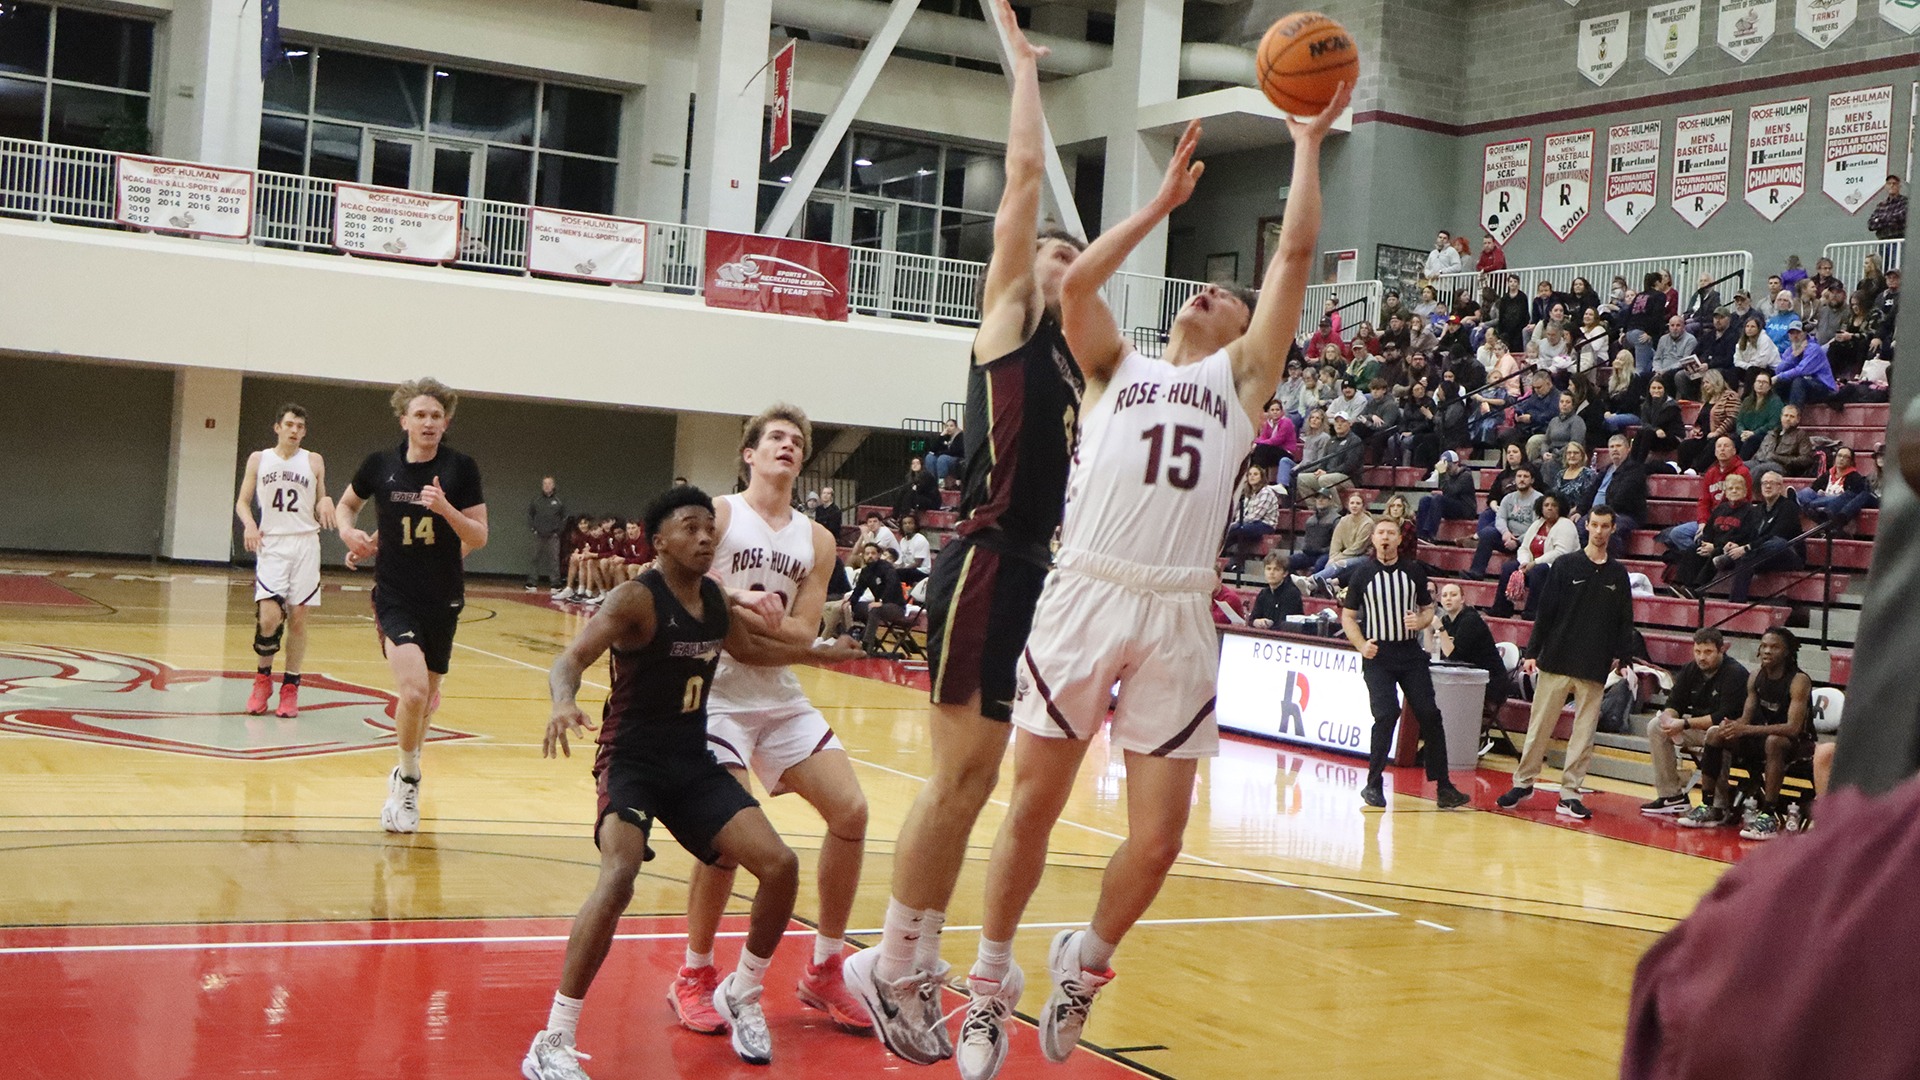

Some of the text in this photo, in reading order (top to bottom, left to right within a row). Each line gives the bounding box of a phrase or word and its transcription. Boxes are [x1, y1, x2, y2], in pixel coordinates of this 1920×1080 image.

[1660, 14, 1686, 24] UNIVERSITY
[1812, 10, 1840, 22] TRANSY
[1590, 19, 1619, 30] MANCHESTER
[1592, 26, 1617, 36] UNIVERSITY
[1812, 23, 1838, 33] PIONEERS
[1591, 62, 1613, 72] SPARTANS
[1844, 111, 1872, 123] MEN'S
[1765, 123, 1791, 135] MEN'S
[1828, 120, 1888, 136] BASKETBALL
[1610, 138, 1658, 156] MEN'S BASKETBALL
[1691, 134, 1715, 145] MEN'S
[1750, 133, 1805, 148] BASKETBALL
[1829, 134, 1887, 146] REGULAR SEASON
[1546, 151, 1590, 163] BASKETBALL
[1677, 142, 1728, 158] BASKETBALL
[1752, 147, 1803, 165] Heartland
[1828, 141, 1886, 159] CHAMPIONS
[1486, 160, 1527, 171] BASKETBALL
[1558, 161, 1578, 170] SCAC
[1611, 155, 1655, 172] Heartland
[1678, 157, 1726, 173] Heartland
[1497, 169, 1516, 179] SCAC
[1545, 169, 1589, 187] CHAMPIONS
[1610, 172, 1654, 183] TOURNAMENT
[1676, 174, 1725, 184] TOURNAMENT
[1750, 166, 1802, 188] CHAMPIONS
[1846, 176, 1864, 184] 2014
[123, 174, 144, 184] HCAC
[172, 180, 218, 192] ALL-SPORTS
[220, 186, 247, 196] AWARD
[1485, 177, 1526, 195] CHAMPIONS
[1610, 181, 1652, 197] CHAMPIONS
[1676, 181, 1725, 198] CHAMPIONS
[128, 185, 241, 204] 2008 2013 2015 2017
[128, 194, 240, 214] 2009 2014 2016 2018
[128, 204, 150, 214] 2010
[340, 202, 363, 211] HCAC
[366, 205, 436, 220] COMMISSIONER'S
[438, 214, 454, 222] CUP
[127, 213, 149, 223] 2012
[345, 212, 422, 228] 2008 2016 2018
[1560, 206, 1585, 235] 2001
[344, 221, 394, 234] 2010 2017
[344, 230, 365, 239] 2014
[535, 225, 552, 233] HCAC
[554, 228, 582, 237] WOMEN'S
[583, 231, 619, 242] ALL-SPORTS
[621, 236, 642, 244] AWARD
[1500, 213, 1523, 240] 1999
[344, 239, 365, 248] 2015
[760, 275, 825, 287] RECREATION CENTER
[776, 270, 802, 278] SPORTS
[783, 288, 808, 296] YEARS
[1140, 423, 1204, 491] 15
[272, 488, 299, 512] 42
[401, 516, 435, 545] 14
[732, 548, 806, 585] ROSE-HULMA
[1253, 642, 1361, 674] ROSE-HULMA
[682, 675, 704, 713] 0
[1318, 720, 1361, 748] CLUB
